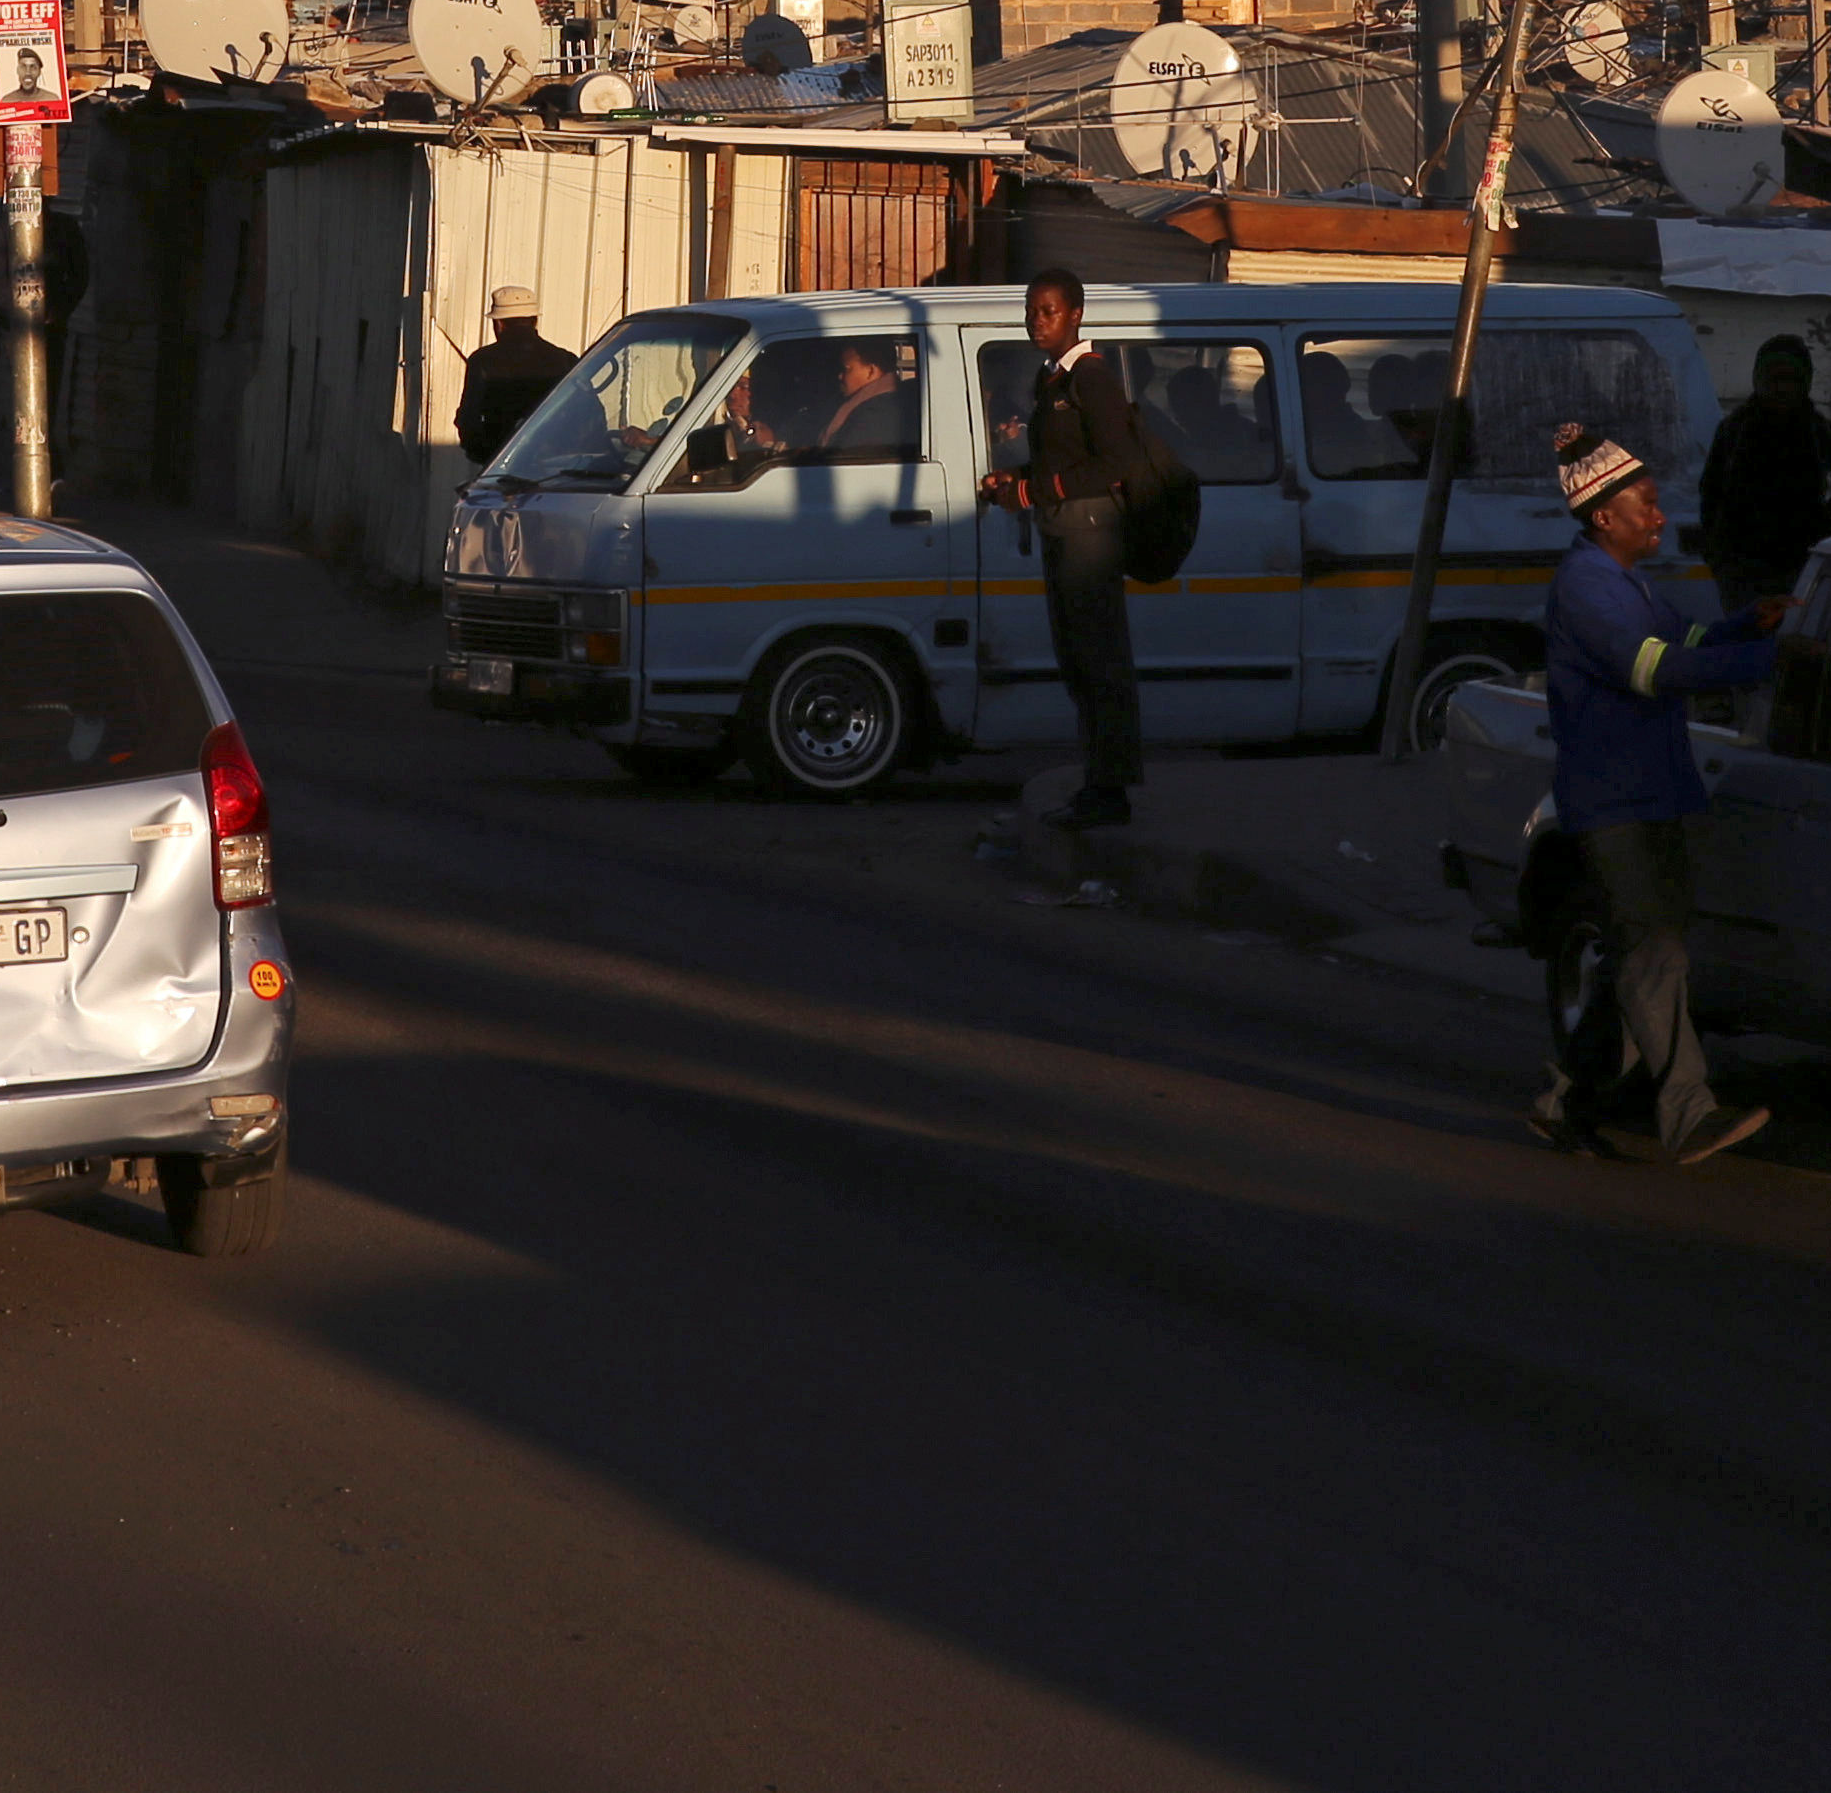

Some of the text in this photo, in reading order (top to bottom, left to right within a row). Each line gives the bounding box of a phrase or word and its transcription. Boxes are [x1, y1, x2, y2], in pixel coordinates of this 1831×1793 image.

[31, 2, 56, 19] EFF
[1149, 61, 1185, 76] ELSAT
[907, 67, 954, 88] A2319
[14, 918, 51, 955] GP
[257, 971, 273, 981] 100
